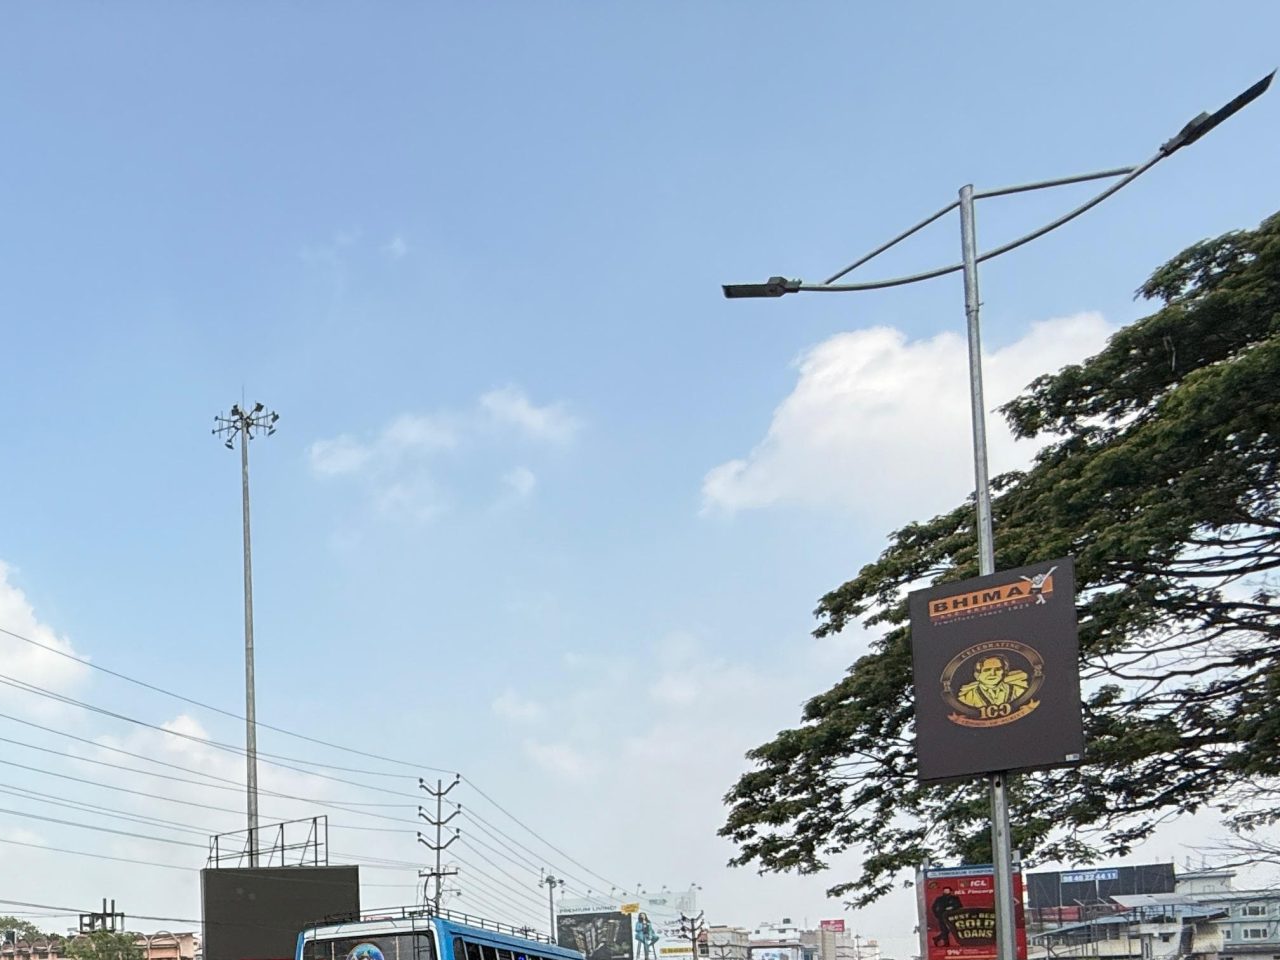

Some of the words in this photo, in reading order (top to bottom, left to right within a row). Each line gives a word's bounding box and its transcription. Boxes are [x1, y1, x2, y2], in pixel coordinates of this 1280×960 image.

[933, 586, 1024, 613] BHIMA
[955, 919, 995, 930] GOLD
[957, 929, 993, 939] LOANS
